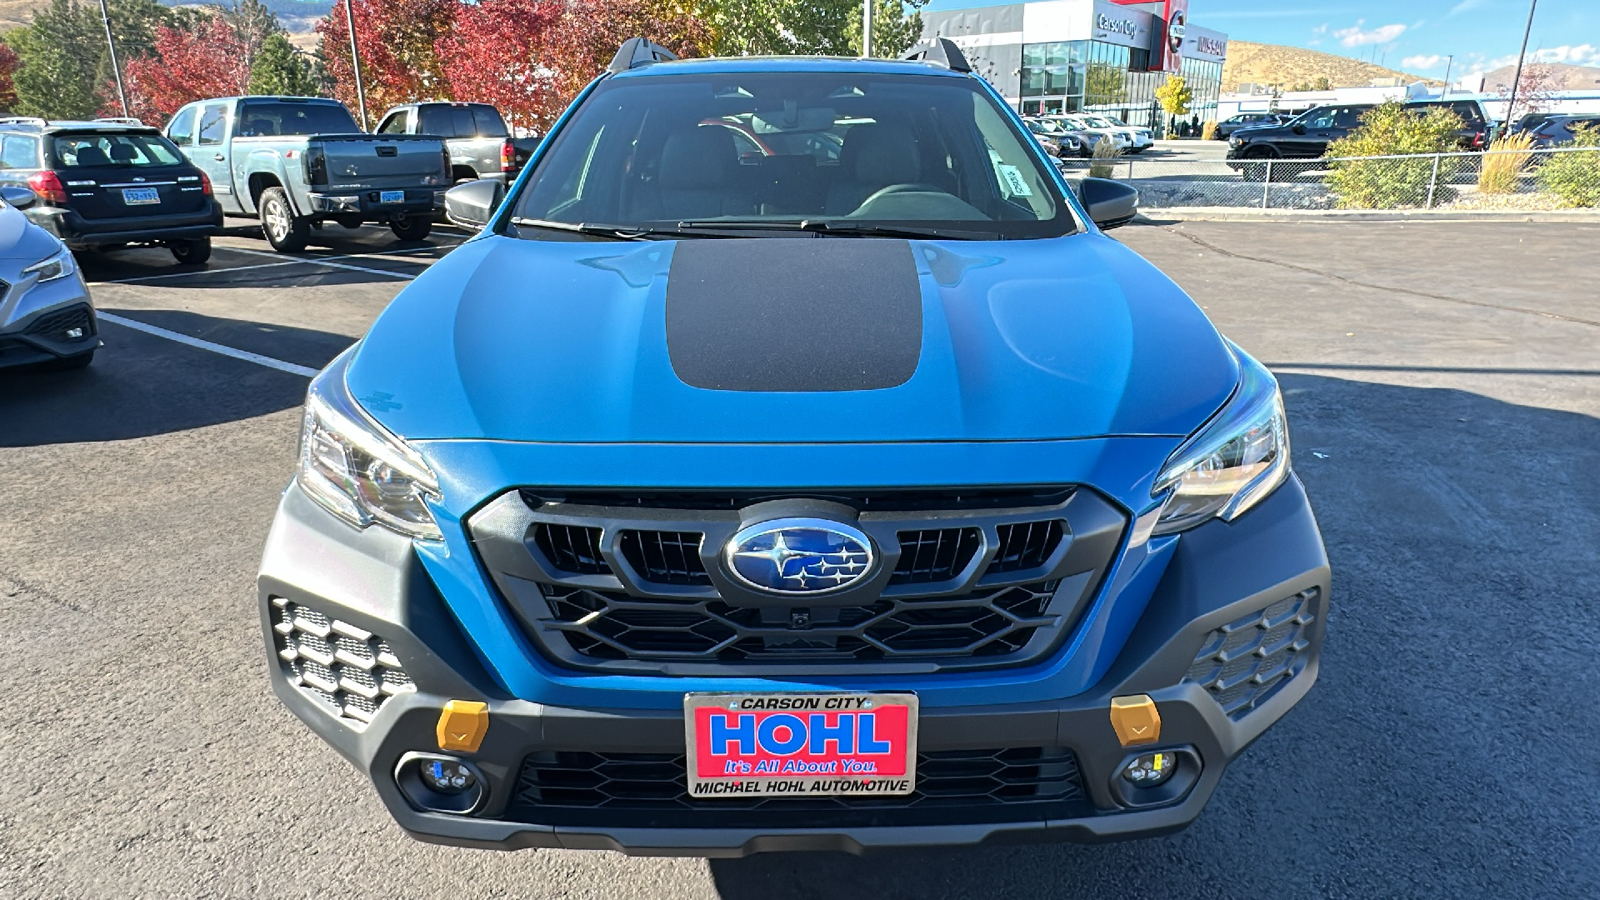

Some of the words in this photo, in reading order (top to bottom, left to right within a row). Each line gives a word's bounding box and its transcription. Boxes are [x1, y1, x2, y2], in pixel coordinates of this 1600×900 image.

[1098, 13, 1124, 33] Carson
[1125, 20, 1138, 39] City
[1198, 36, 1226, 56] NISSAN
[740, 698, 820, 709] CARSON
[825, 697, 867, 709] CITY
[710, 713, 891, 755] HOHL
[724, 760, 752, 773] It's
[754, 760, 780, 773] All
[782, 760, 837, 773] About
[841, 759, 877, 773] You.
[694, 781, 761, 793] MICHAEL
[766, 780, 805, 792] HOHL
[810, 780, 909, 792] AUTOMOTIVE
